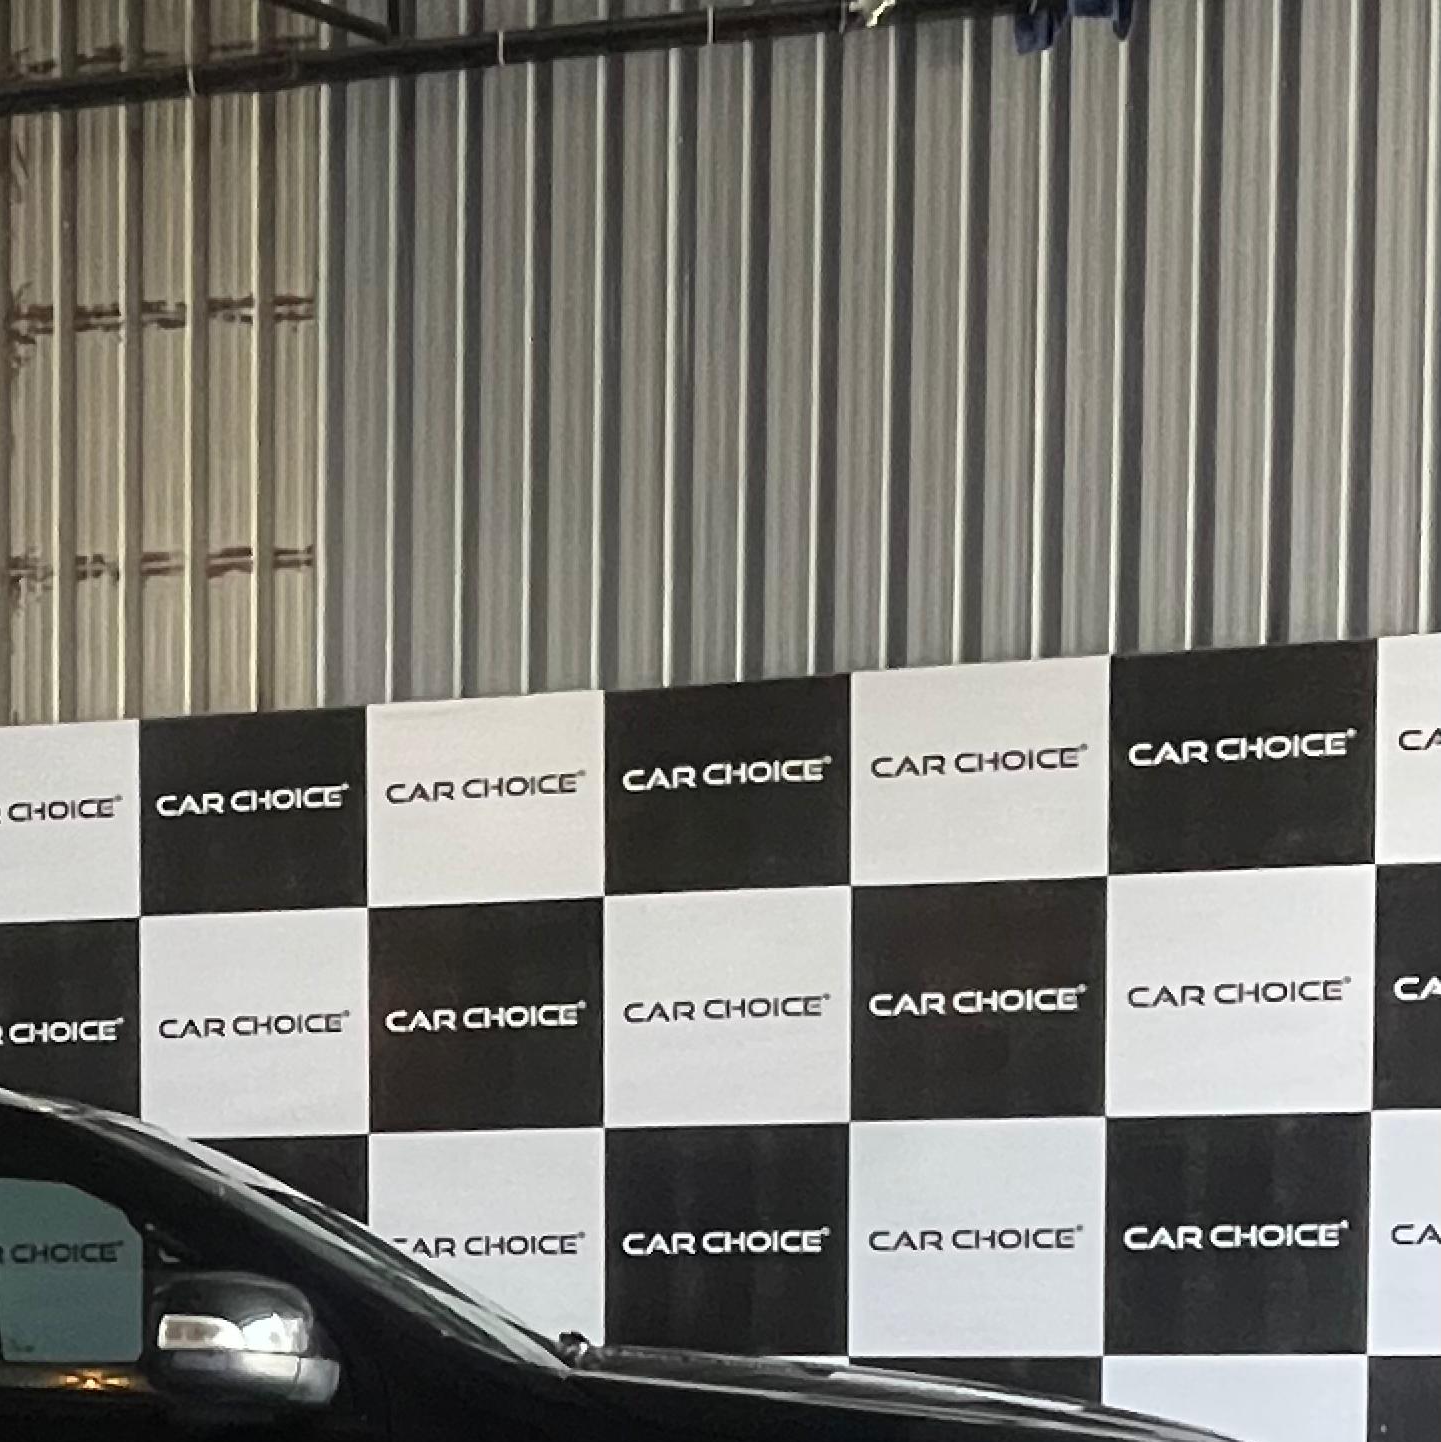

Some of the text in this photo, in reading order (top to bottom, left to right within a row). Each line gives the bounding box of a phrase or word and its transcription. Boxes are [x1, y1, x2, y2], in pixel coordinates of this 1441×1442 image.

[1399, 728, 1441, 750] CA
[1129, 740, 1209, 766] CAR
[623, 766, 697, 790] CAR
[871, 756, 945, 778] CAR
[385, 782, 454, 804] CAR
[157, 793, 224, 816] CAR
[1128, 986, 1205, 1008] CAR
[1394, 976, 1441, 1000] CA
[623, 1002, 695, 1022] CAR
[869, 992, 945, 1016] CAR
[159, 1018, 225, 1038] CAR
[385, 1010, 456, 1032] CAR
[623, 1232, 695, 1255] CAR
[869, 1230, 943, 1250] CAR
[1123, 1226, 1203, 1250] CAR
[1391, 1224, 1441, 1244] CA
[393, 1237, 456, 1258] AR
